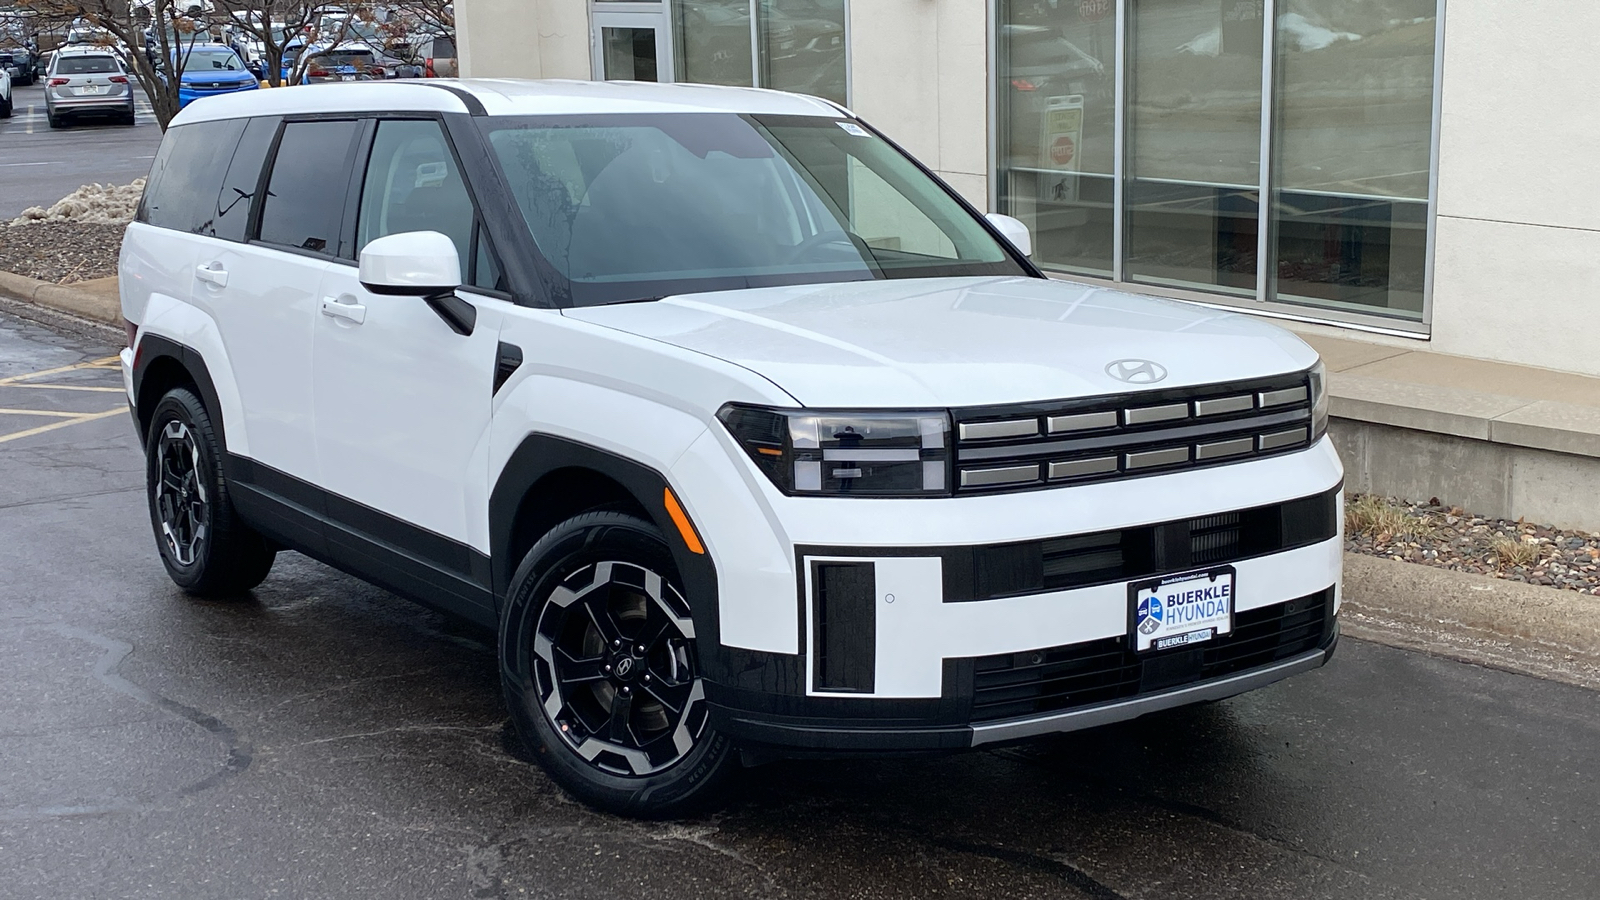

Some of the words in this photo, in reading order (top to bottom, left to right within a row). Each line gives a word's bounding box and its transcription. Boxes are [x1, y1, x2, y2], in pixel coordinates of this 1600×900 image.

[1167, 584, 1230, 608] BUERKLE
[1166, 597, 1229, 625] HYUNDAI
[1158, 633, 1188, 648] BUERKLE
